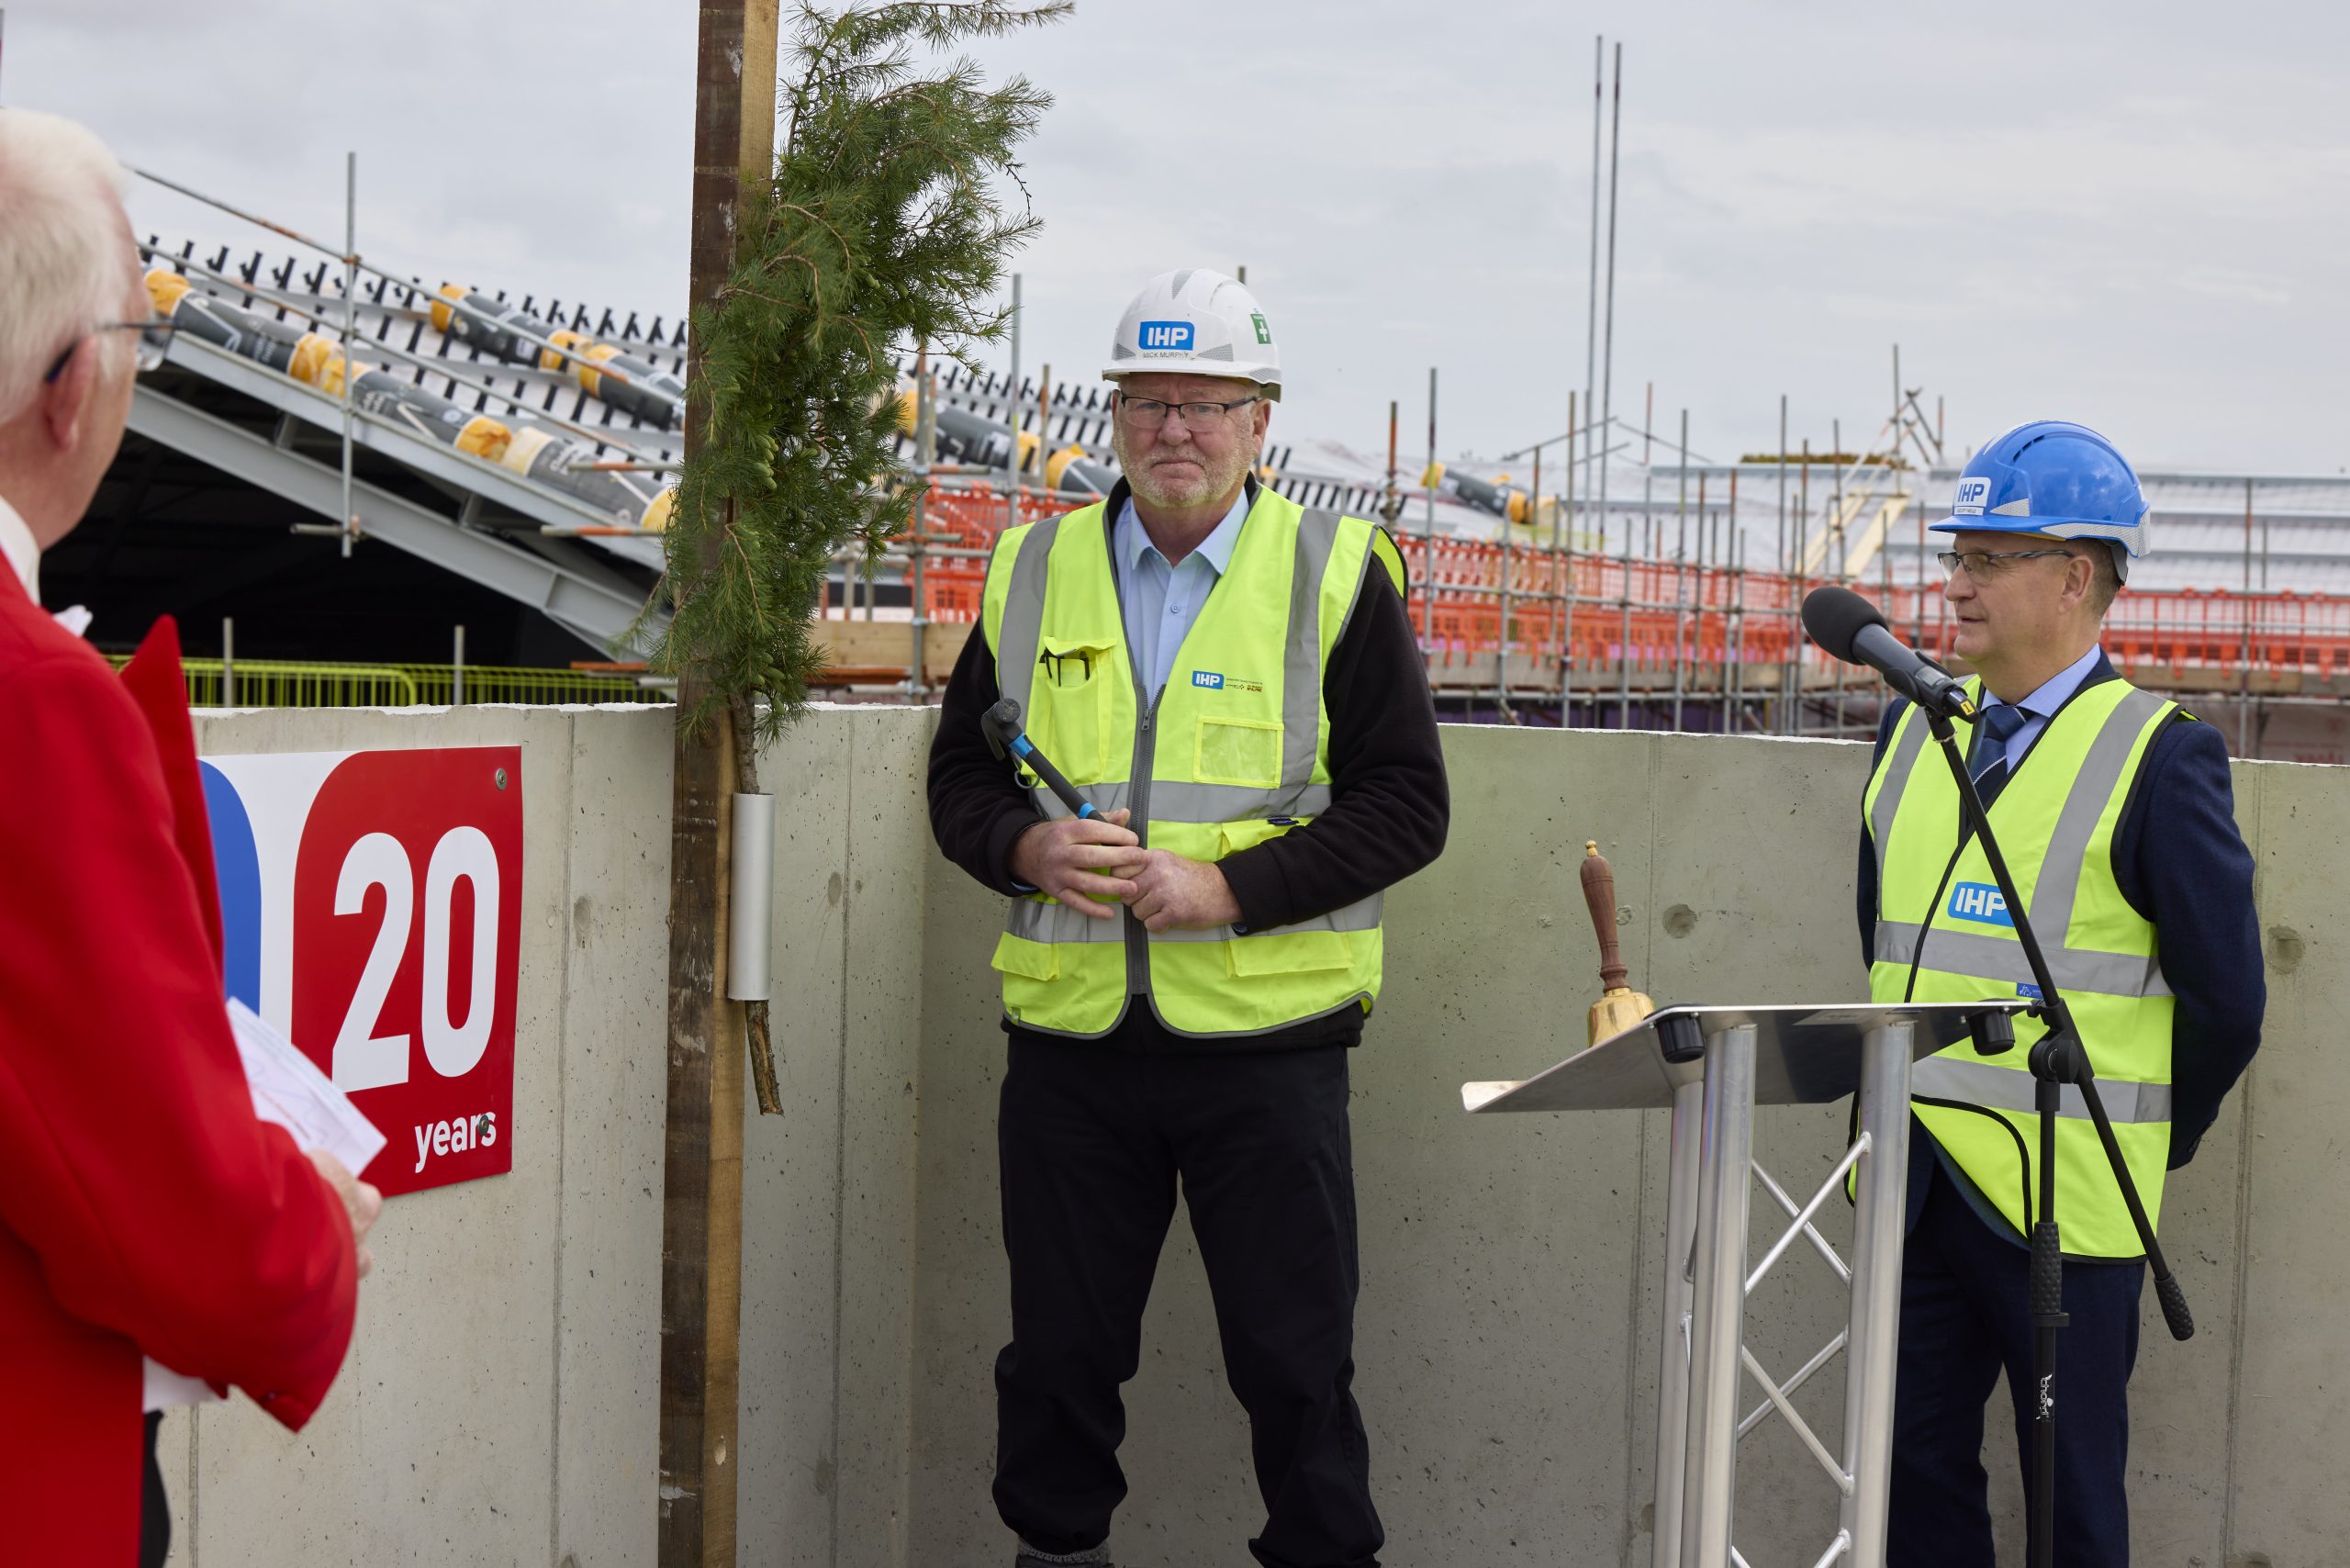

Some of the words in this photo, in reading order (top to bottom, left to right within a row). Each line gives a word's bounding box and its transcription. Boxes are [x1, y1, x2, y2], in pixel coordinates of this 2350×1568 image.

[1147, 327, 1189, 347] IHP
[1957, 483, 1985, 502] IHP
[1195, 673, 1221, 687] IHP
[1954, 887, 2008, 917] IHP
[331, 824, 500, 1094] 20
[414, 1111, 497, 1174] years
